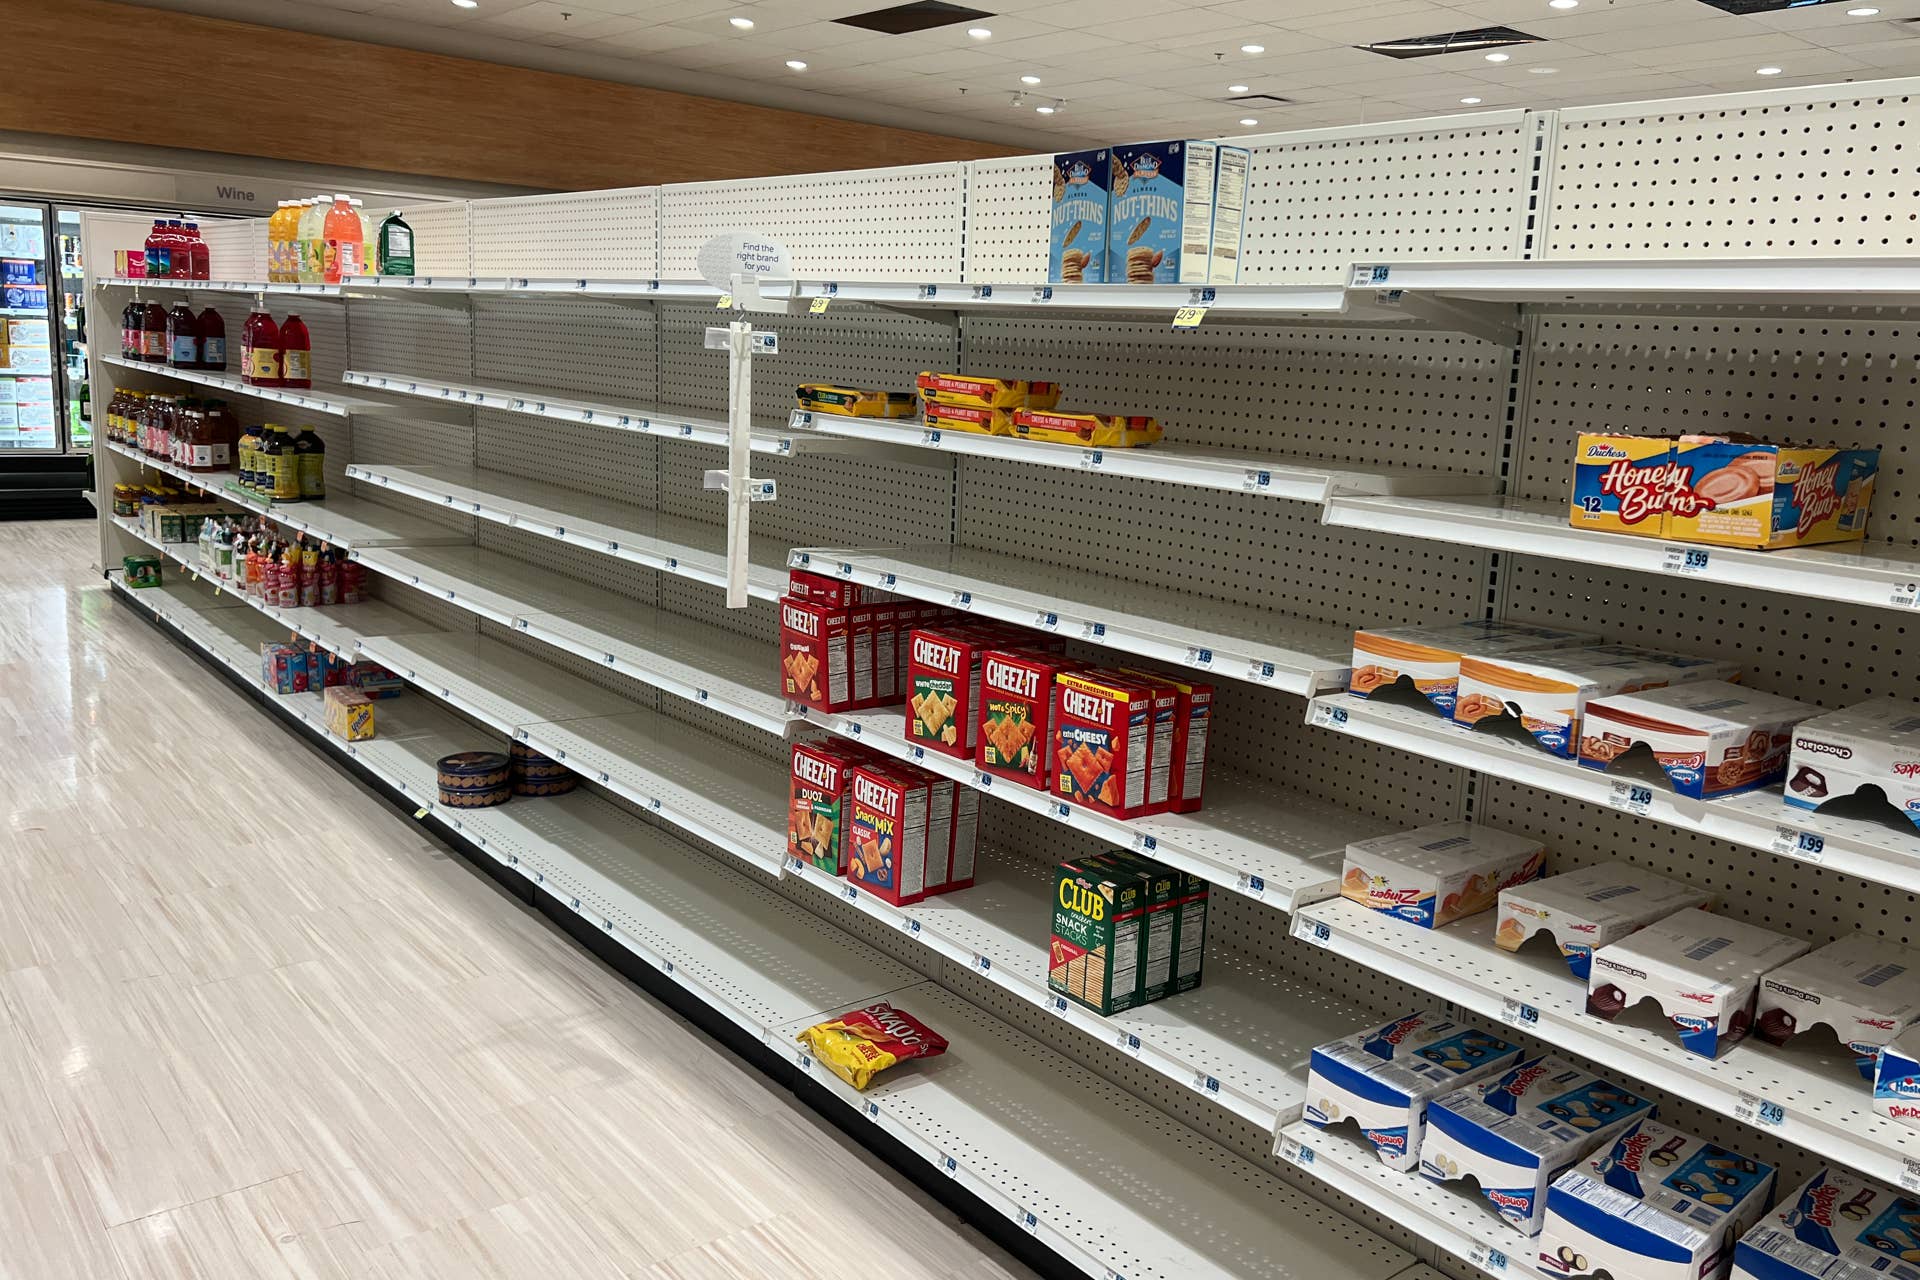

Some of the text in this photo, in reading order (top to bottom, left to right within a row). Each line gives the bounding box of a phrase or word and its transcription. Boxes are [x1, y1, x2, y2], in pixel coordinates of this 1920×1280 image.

[216, 185, 255, 201] Wine
[1052, 199, 1104, 229] NUT-THINS
[1113, 194, 1178, 225] NUT-THINS
[742, 242, 774, 252] Find the
[736, 252, 778, 263] right brand
[744, 261, 770, 273] for you
[1587, 445, 1627, 458] Duchess
[1794, 463, 1839, 503] Honey
[1582, 497, 1601, 512] 12
[1800, 492, 1839, 533] Buns
[1685, 552, 1708, 567] 3.99
[930, 680, 952, 692] cheddar
[1066, 679, 1083, 689] EXTRA
[990, 703, 1001, 712] HOT
[1005, 702, 1027, 719] Spicy
[1333, 709, 1348, 722] 4.29
[1074, 729, 1108, 745] CHEESY
[1796, 739, 1852, 759] Chocolate
[1678, 753, 1703, 768] Coffee
[1669, 769, 1700, 783] Hostess
[802, 788, 822, 803] DUOZ
[1630, 788, 1651, 804] 2.49
[855, 806, 875, 825] Snack
[852, 826, 871, 839] CLASSIC
[1776, 825, 1798, 837] EVERYDAY
[1780, 831, 1792, 842] PRICE
[1799, 834, 1823, 853] 1.99
[1155, 880, 1171, 894] CLUB
[1060, 878, 1104, 921] CLUB
[1121, 889, 1137, 903] CLUB
[1370, 888, 1420, 905] Zingers
[1399, 907, 1427, 919] Hostess
[1056, 913, 1087, 936] SNACK
[1315, 925, 1330, 940] 1.99
[1055, 923, 1088, 946] STACKS
[1596, 957, 1647, 980] Iced Devil's Food
[1680, 992, 1715, 1004] Zingers
[1766, 981, 1820, 1005] Iced Devil's Food
[1520, 1005, 1539, 1023] 1.99
[1675, 1015, 1708, 1030] Hostess
[1855, 1016, 1896, 1030] Zingers
[1382, 1018, 1425, 1045] donettes
[1851, 1043, 1880, 1056] ostess
[1206, 1077, 1220, 1093] 6.69
[1503, 1066, 1548, 1096] donettes
[1760, 1102, 1783, 1122] 2.49
[1368, 1131, 1404, 1149] donettes
[1299, 1146, 1314, 1162] 2.49
[1617, 1133, 1653, 1173] donettes
[1489, 1190, 1528, 1210] donettes
[1807, 1184, 1840, 1227] donettes
[1489, 1249, 1506, 1267] 2.49
